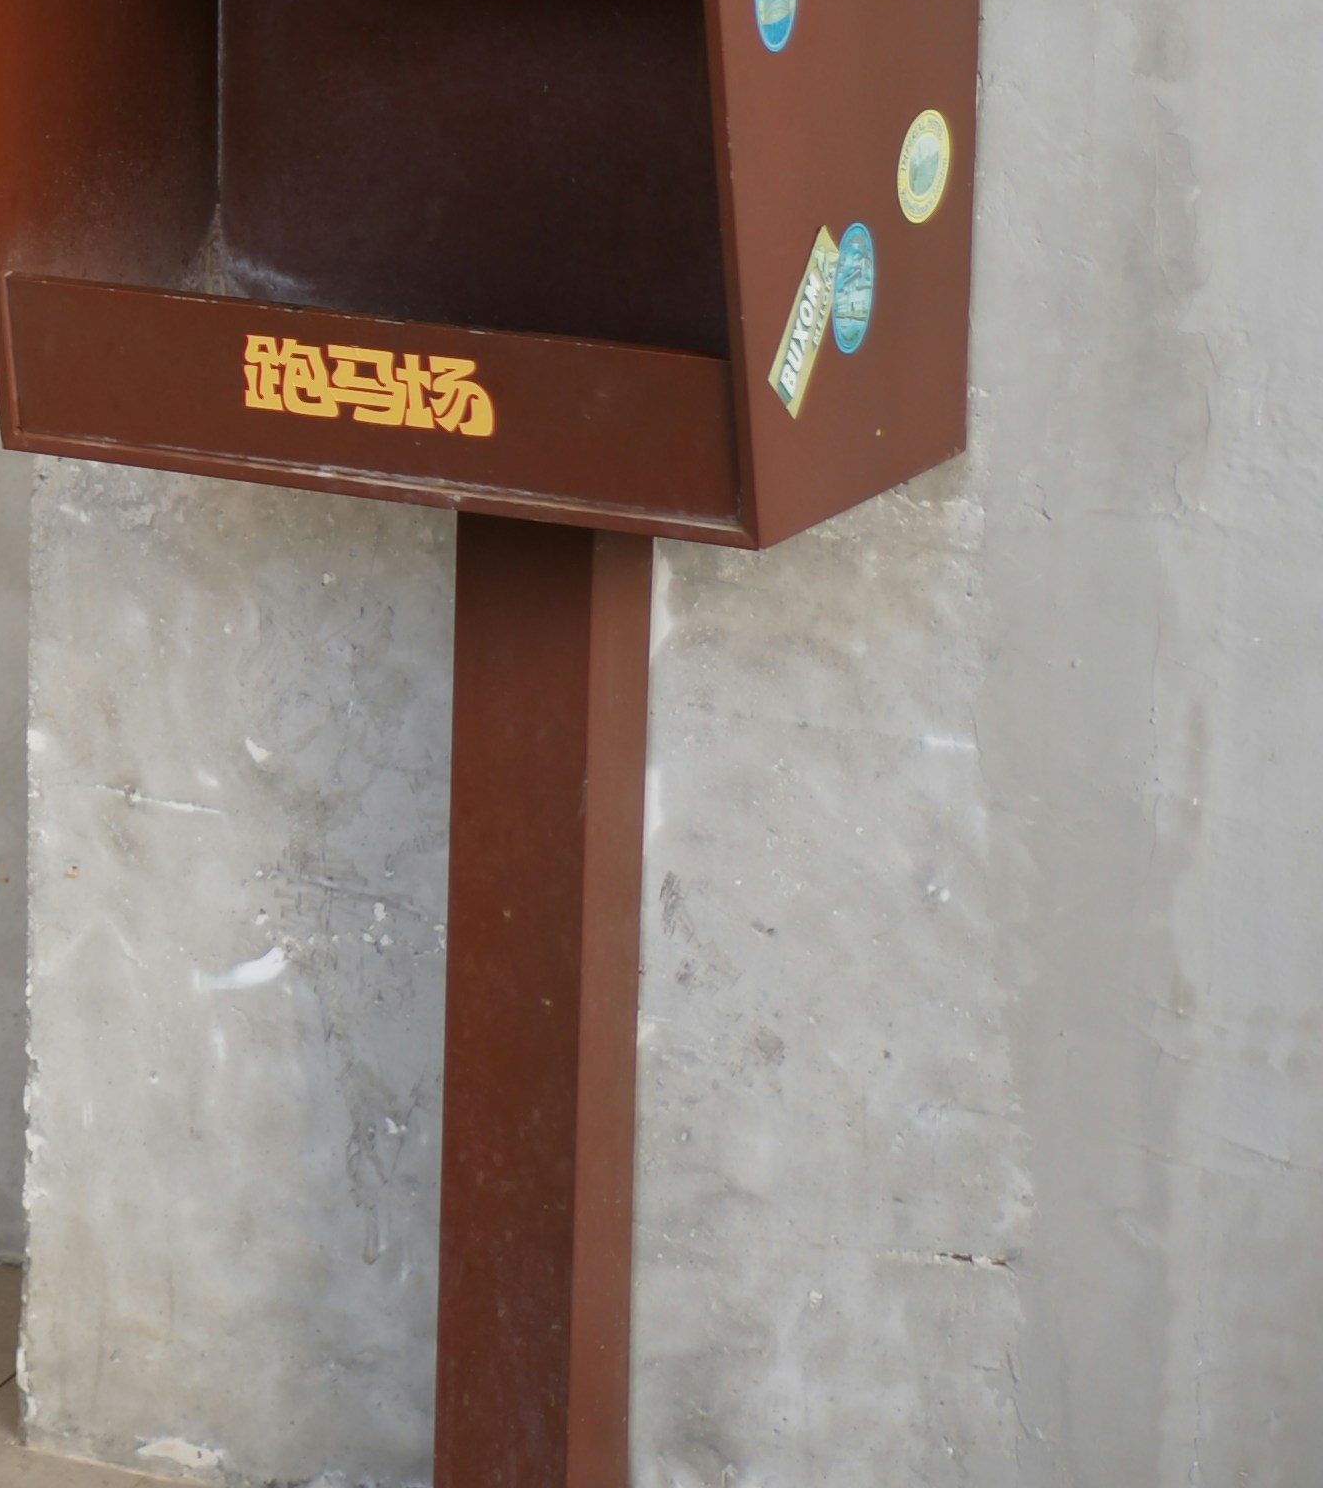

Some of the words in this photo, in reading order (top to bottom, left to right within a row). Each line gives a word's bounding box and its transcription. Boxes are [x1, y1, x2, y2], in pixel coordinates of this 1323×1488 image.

[244, 334, 494, 437] 跑马场
[780, 271, 821, 399] BUXOM
